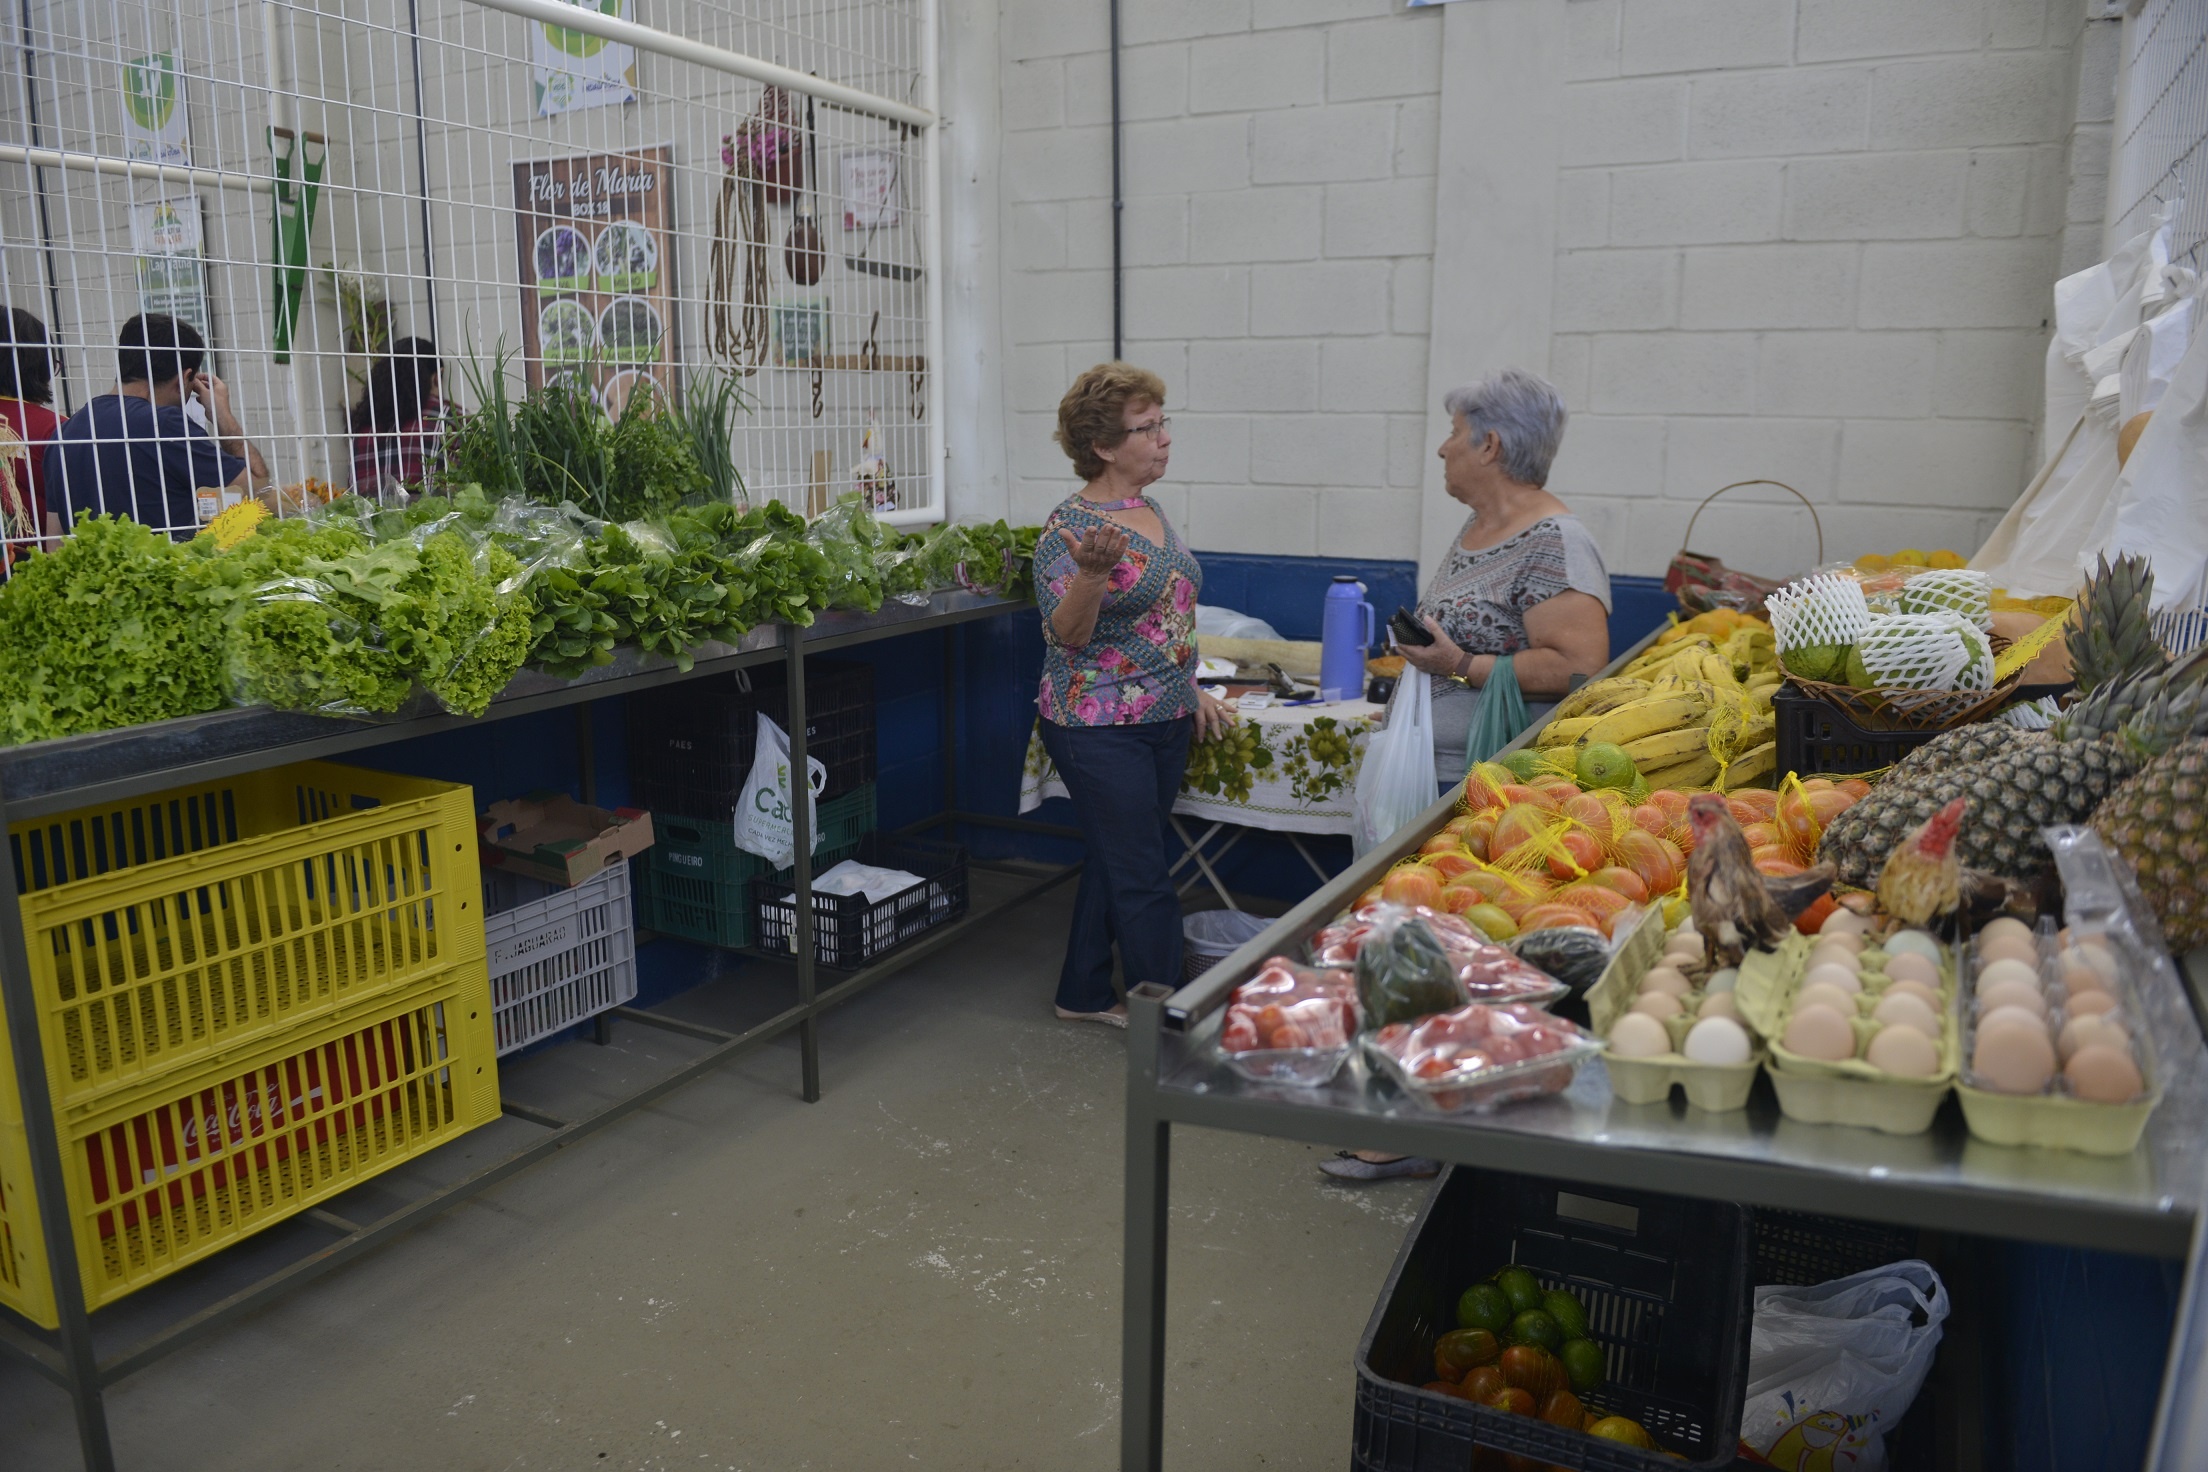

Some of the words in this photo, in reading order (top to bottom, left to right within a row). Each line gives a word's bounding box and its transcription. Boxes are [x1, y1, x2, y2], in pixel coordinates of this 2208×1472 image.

[138, 59, 163, 99] 17
[528, 173, 566, 202] Flor
[569, 172, 591, 198] de
[573, 202, 595, 217] BOX
[669, 739, 693, 750] PAES
[764, 835, 775, 843] VEZ
[776, 838, 794, 848] MELH
[668, 852, 703, 867] PINGUEIRO
